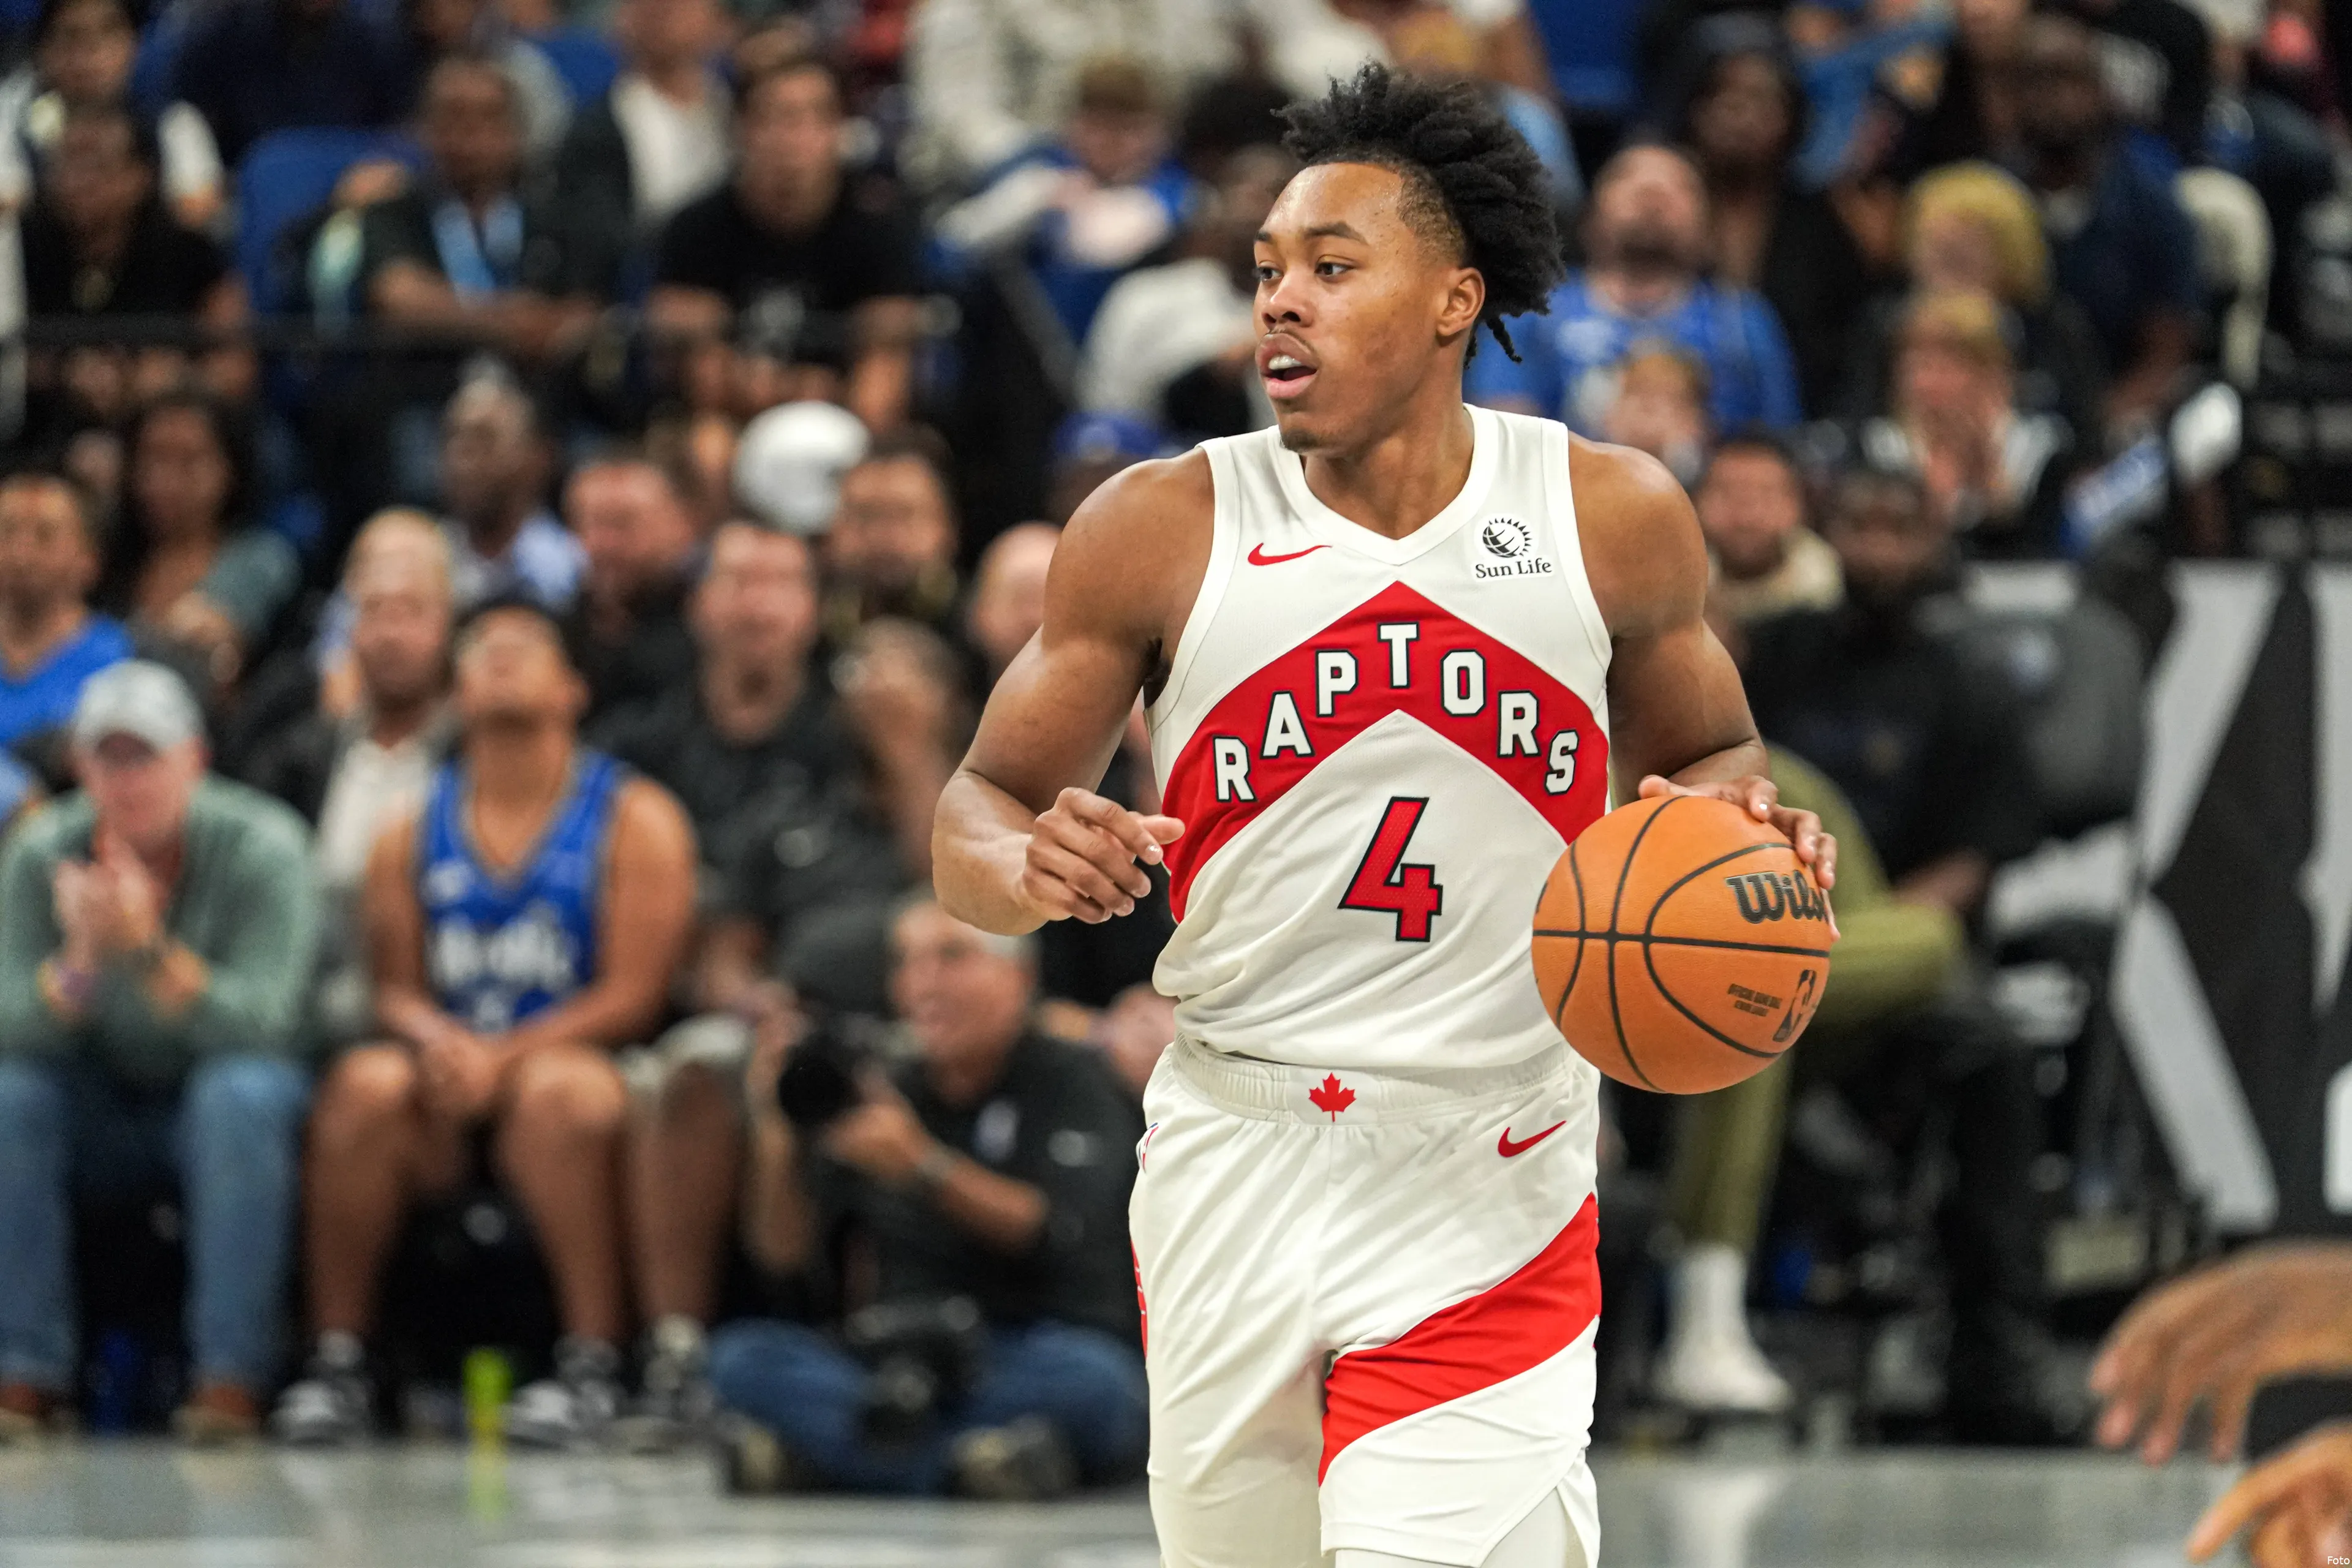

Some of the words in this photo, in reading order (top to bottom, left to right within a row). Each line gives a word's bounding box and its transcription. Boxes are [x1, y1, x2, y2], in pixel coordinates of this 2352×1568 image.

[1475, 564, 1513, 579] Sun
[1515, 557, 1553, 575] Life
[1213, 622, 1578, 803] RAPTORS
[1338, 796, 1443, 943] 4
[1724, 869, 1830, 926] Wils
